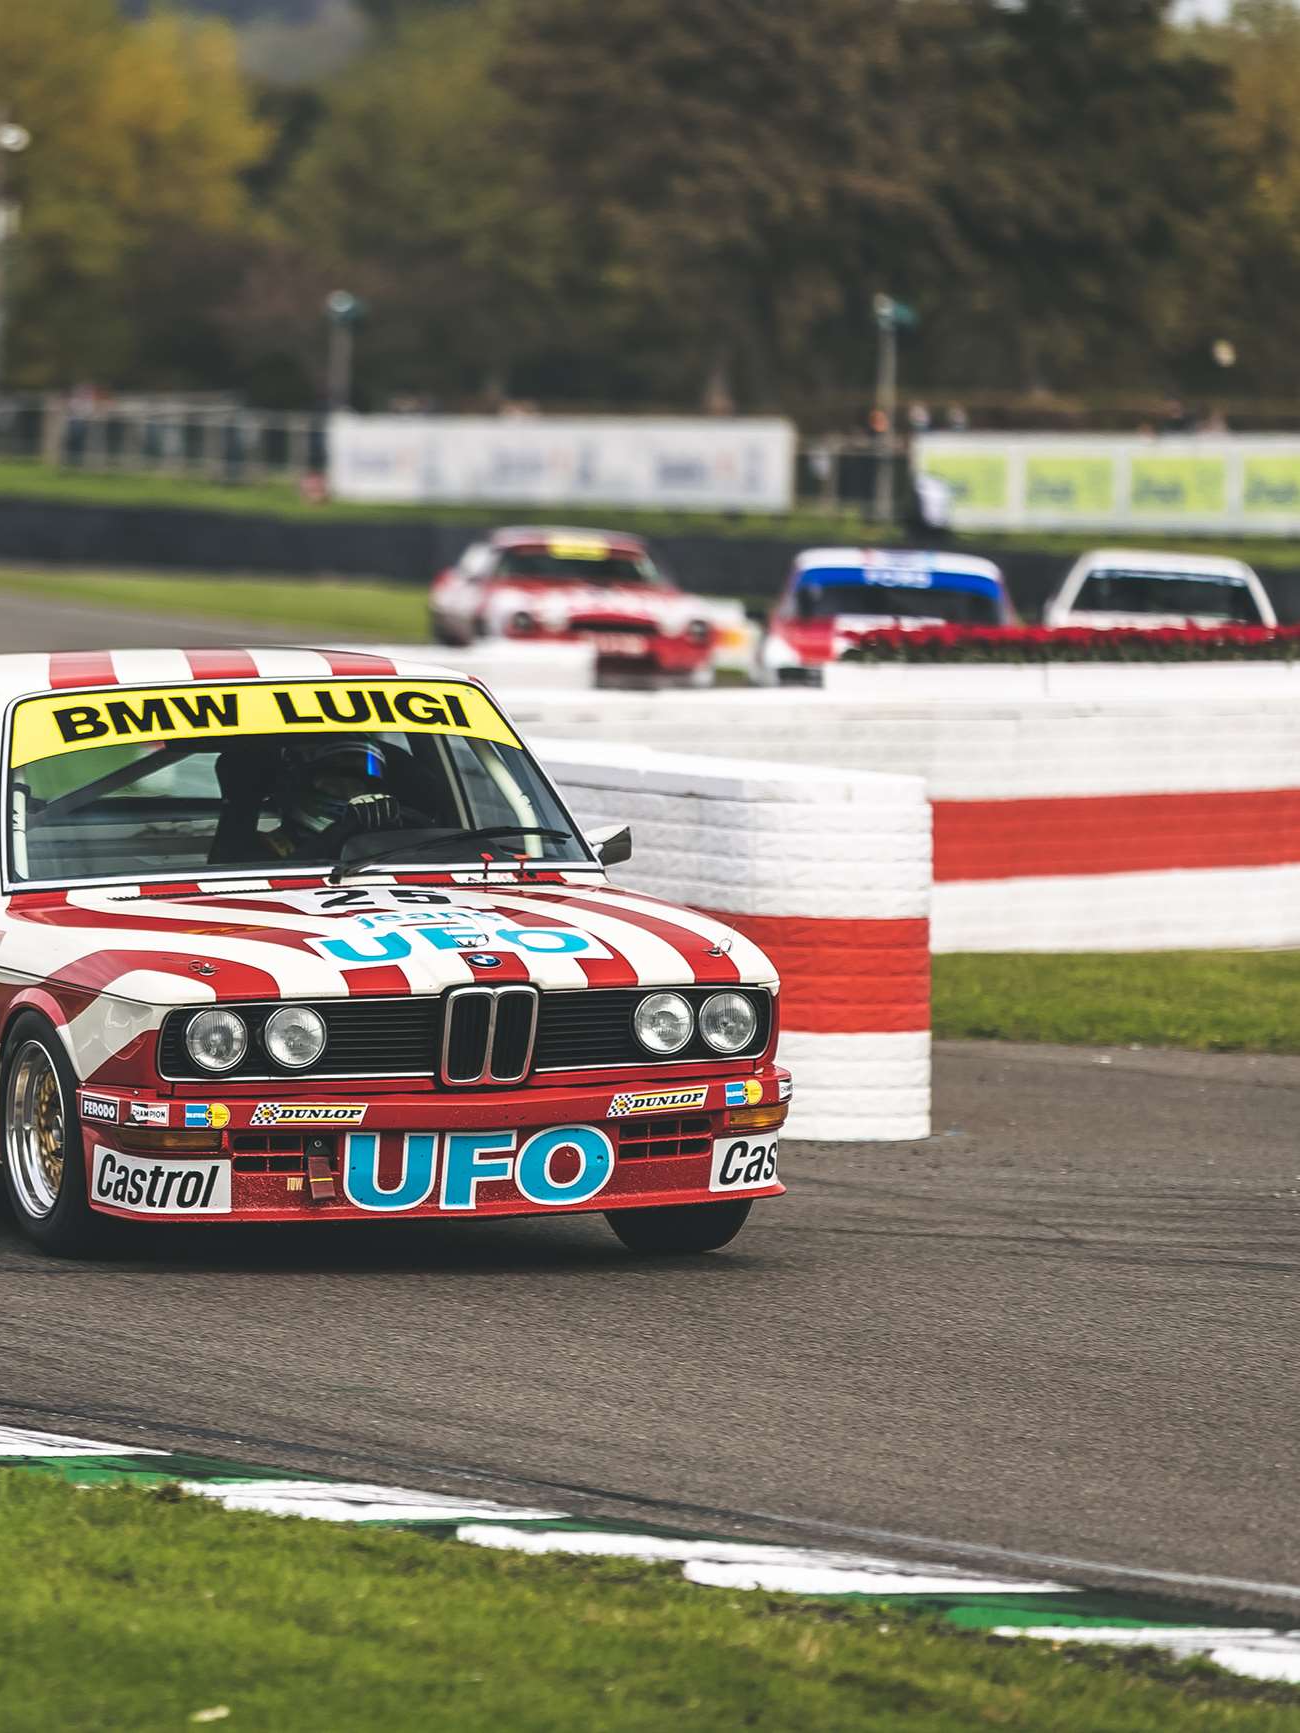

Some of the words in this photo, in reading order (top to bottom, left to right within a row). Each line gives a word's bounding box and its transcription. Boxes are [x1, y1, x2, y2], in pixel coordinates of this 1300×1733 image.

[52, 693, 238, 743] BMW
[271, 691, 470, 728] LUIGI
[314, 889, 452, 908] 25
[353, 911, 502, 930] jeans
[319, 926, 589, 962] UFO
[83, 1100, 115, 1119] FERODO
[632, 1092, 704, 1108] DUNLOP
[132, 1107, 166, 1119] CHAMPION
[279, 1108, 362, 1120] DUNLOP
[343, 1124, 614, 1212] UFO
[96, 1153, 220, 1208] Castrol
